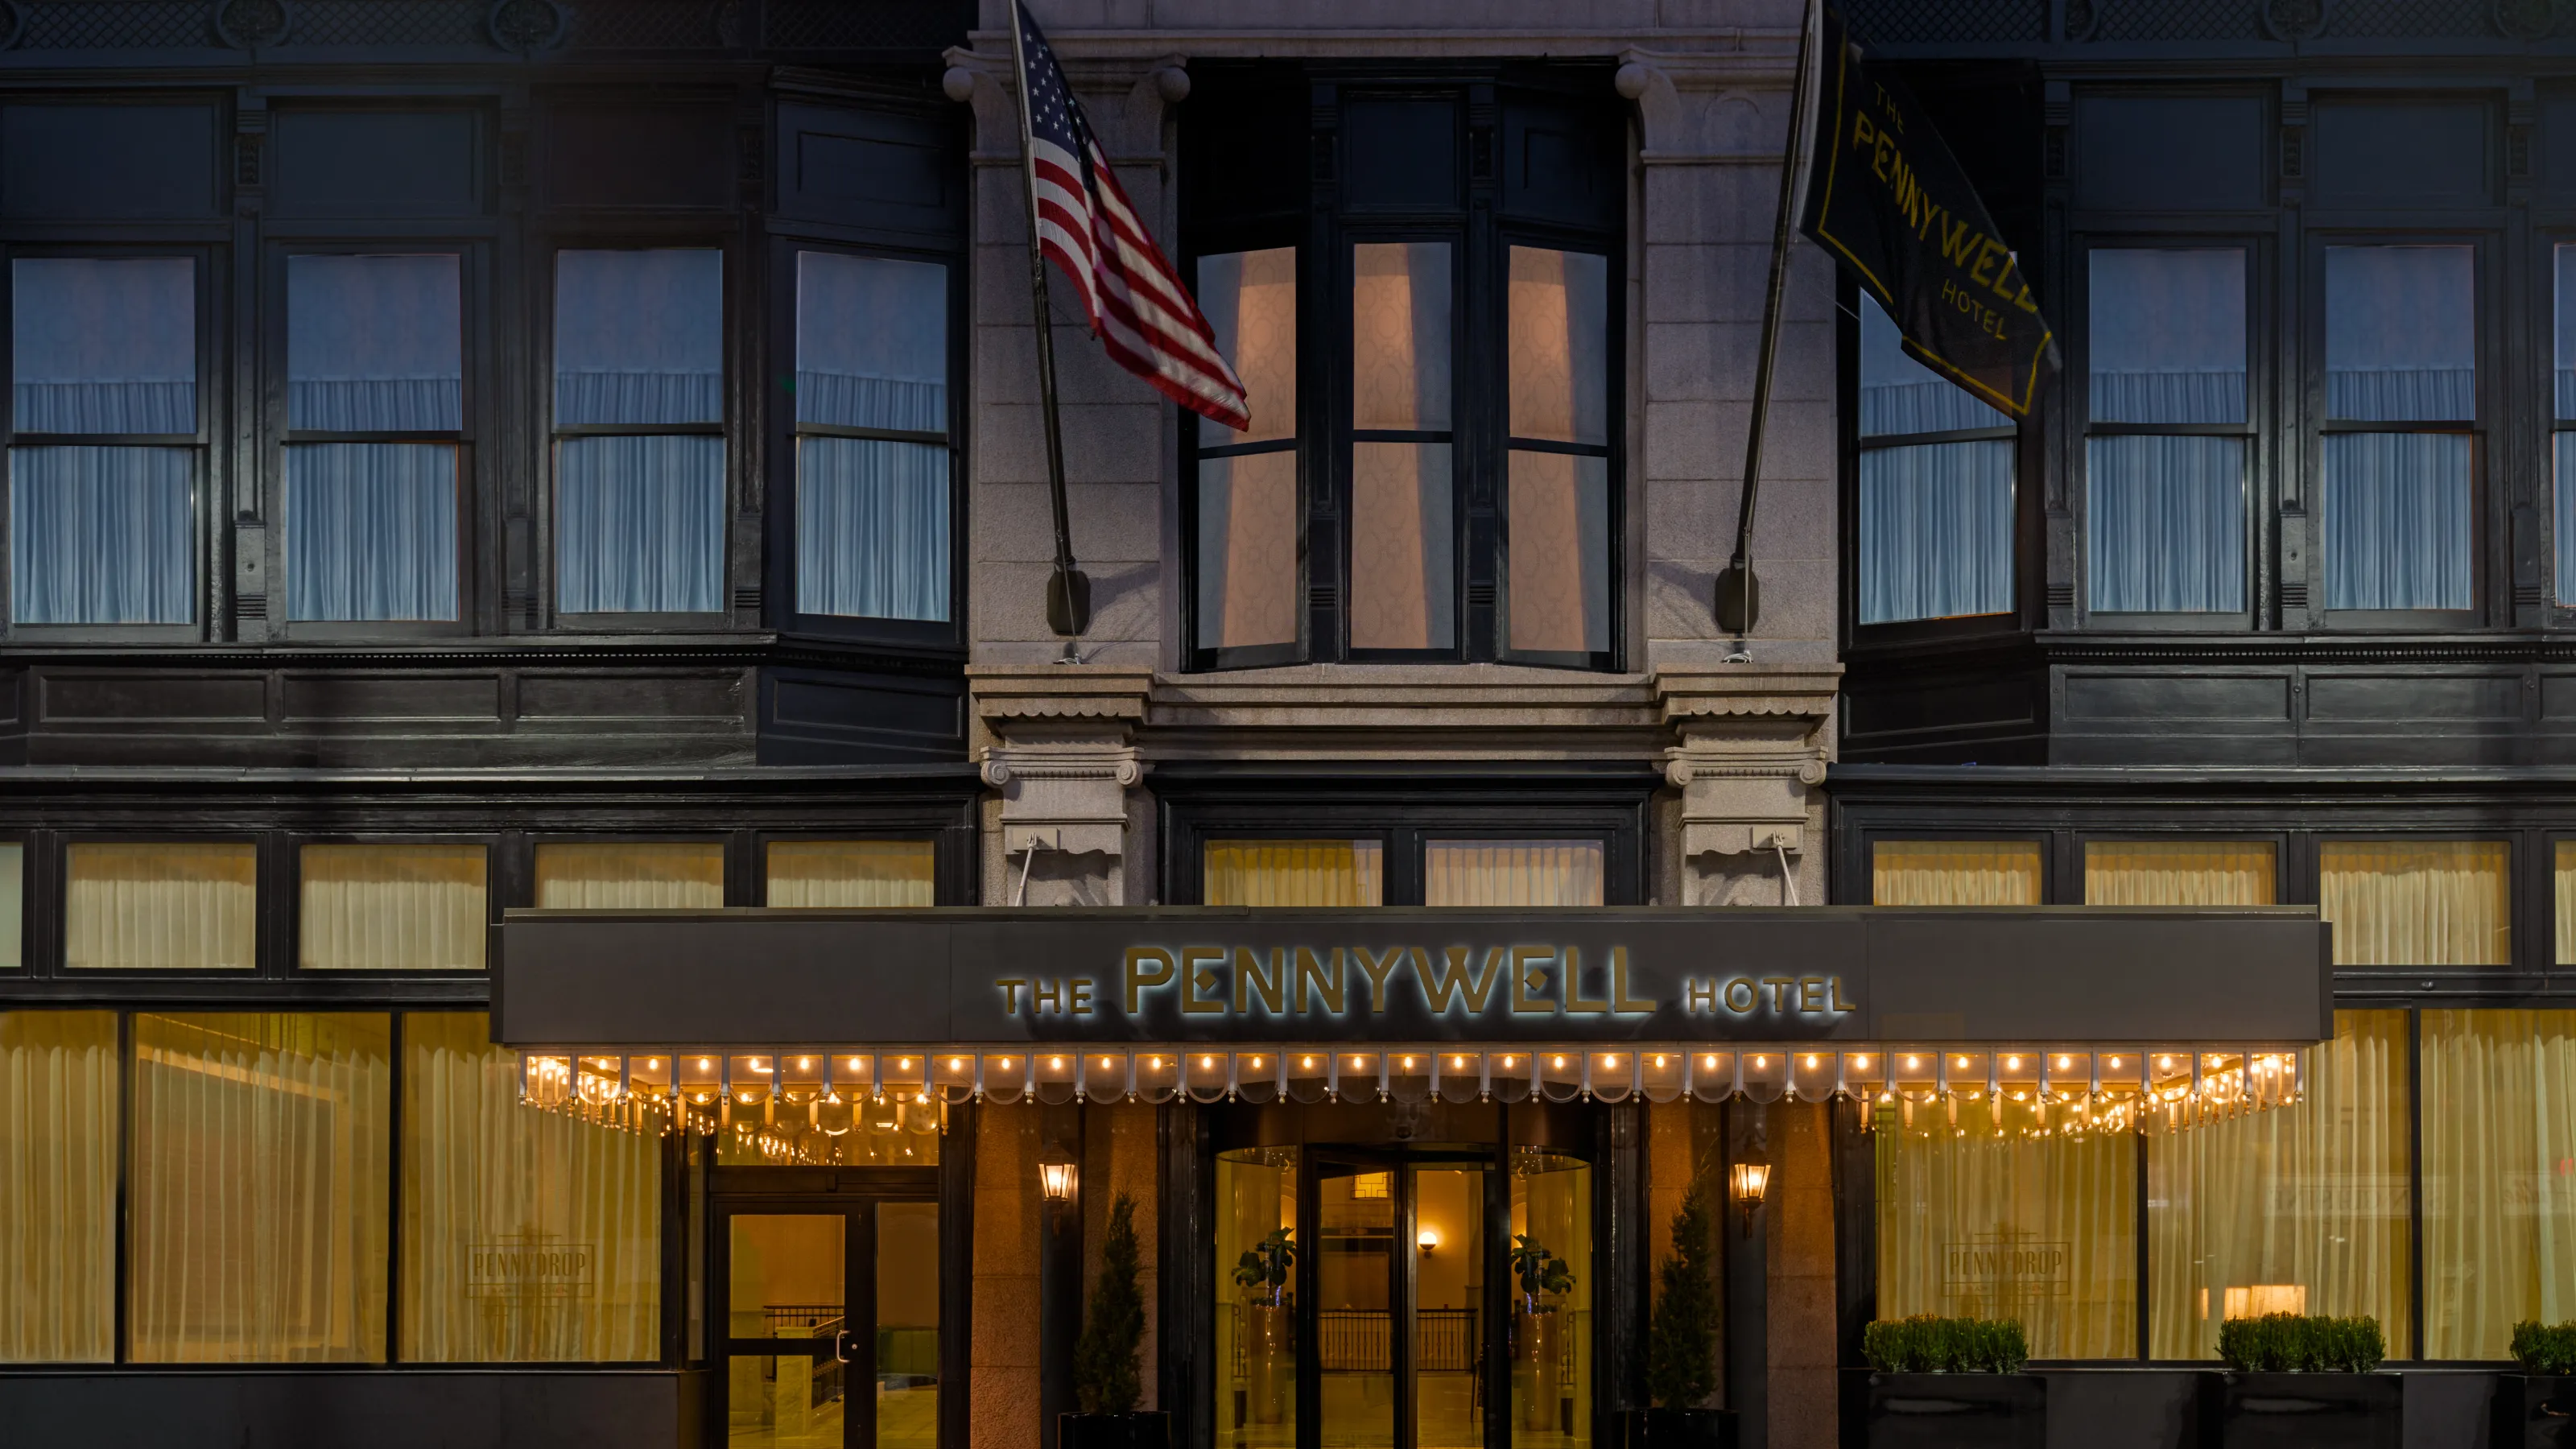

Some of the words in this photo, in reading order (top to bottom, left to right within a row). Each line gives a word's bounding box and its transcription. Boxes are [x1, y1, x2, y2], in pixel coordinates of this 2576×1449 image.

[1874, 80, 1905, 134] THE
[1853, 109, 2037, 313] PENNYWELL
[1942, 278, 2007, 341] HOTEL
[995, 978, 1092, 1013] THE
[1125, 947, 1657, 1013] PENNYWELL
[1688, 976, 1856, 1013] HOTEL
[473, 1253, 586, 1277] PENNYDROP
[1950, 1250, 2062, 1275] PENNYDROP
